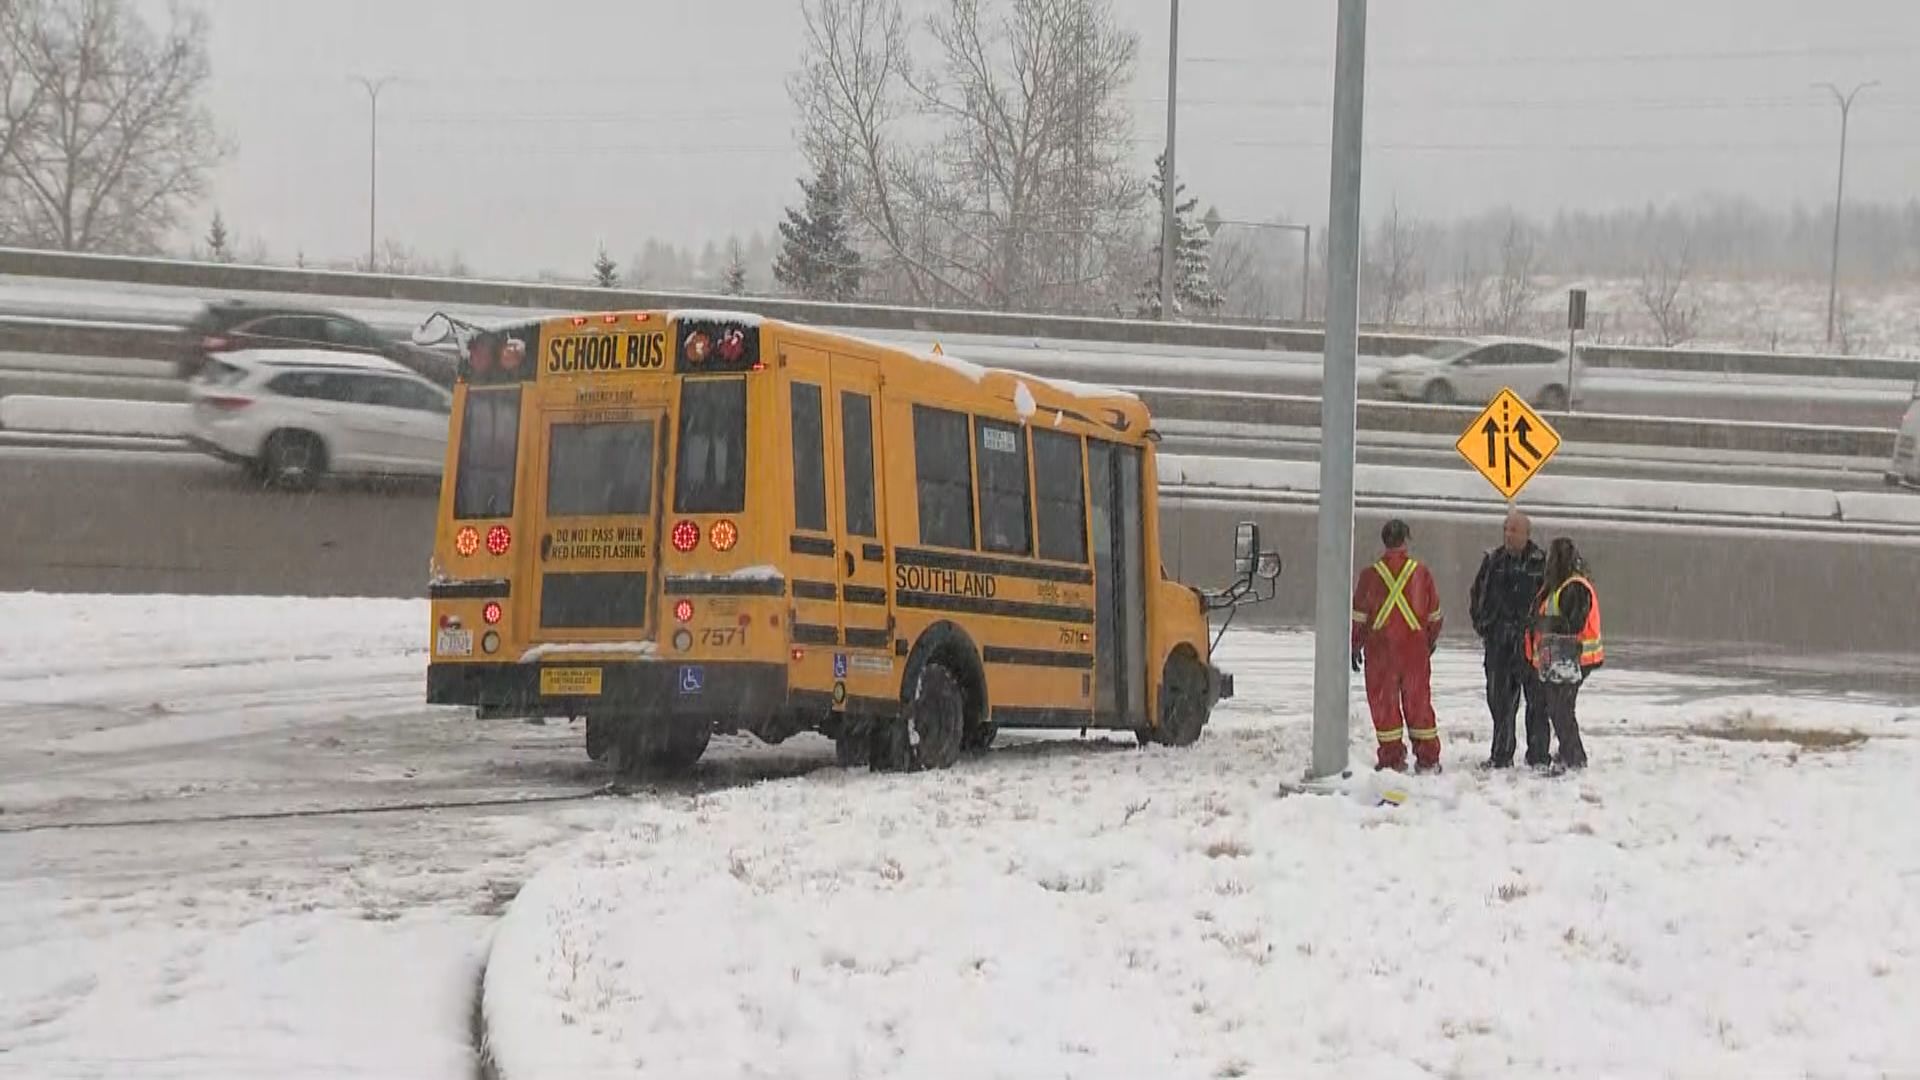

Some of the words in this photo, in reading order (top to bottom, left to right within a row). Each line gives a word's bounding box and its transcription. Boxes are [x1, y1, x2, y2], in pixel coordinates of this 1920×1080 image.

[549, 336, 621, 371] SCHOOL
[626, 333, 664, 368] BUS
[556, 528, 568, 542] DO
[571, 528, 588, 542] NOT
[591, 528, 614, 542] PASS
[617, 527, 643, 541] WHEN
[571, 545, 600, 559] LIGHTS
[603, 545, 646, 559] FLASHING
[895, 564, 996, 598] SOUTHLAND
[698, 627, 746, 647] 7571
[1059, 626, 1080, 648] 7571
